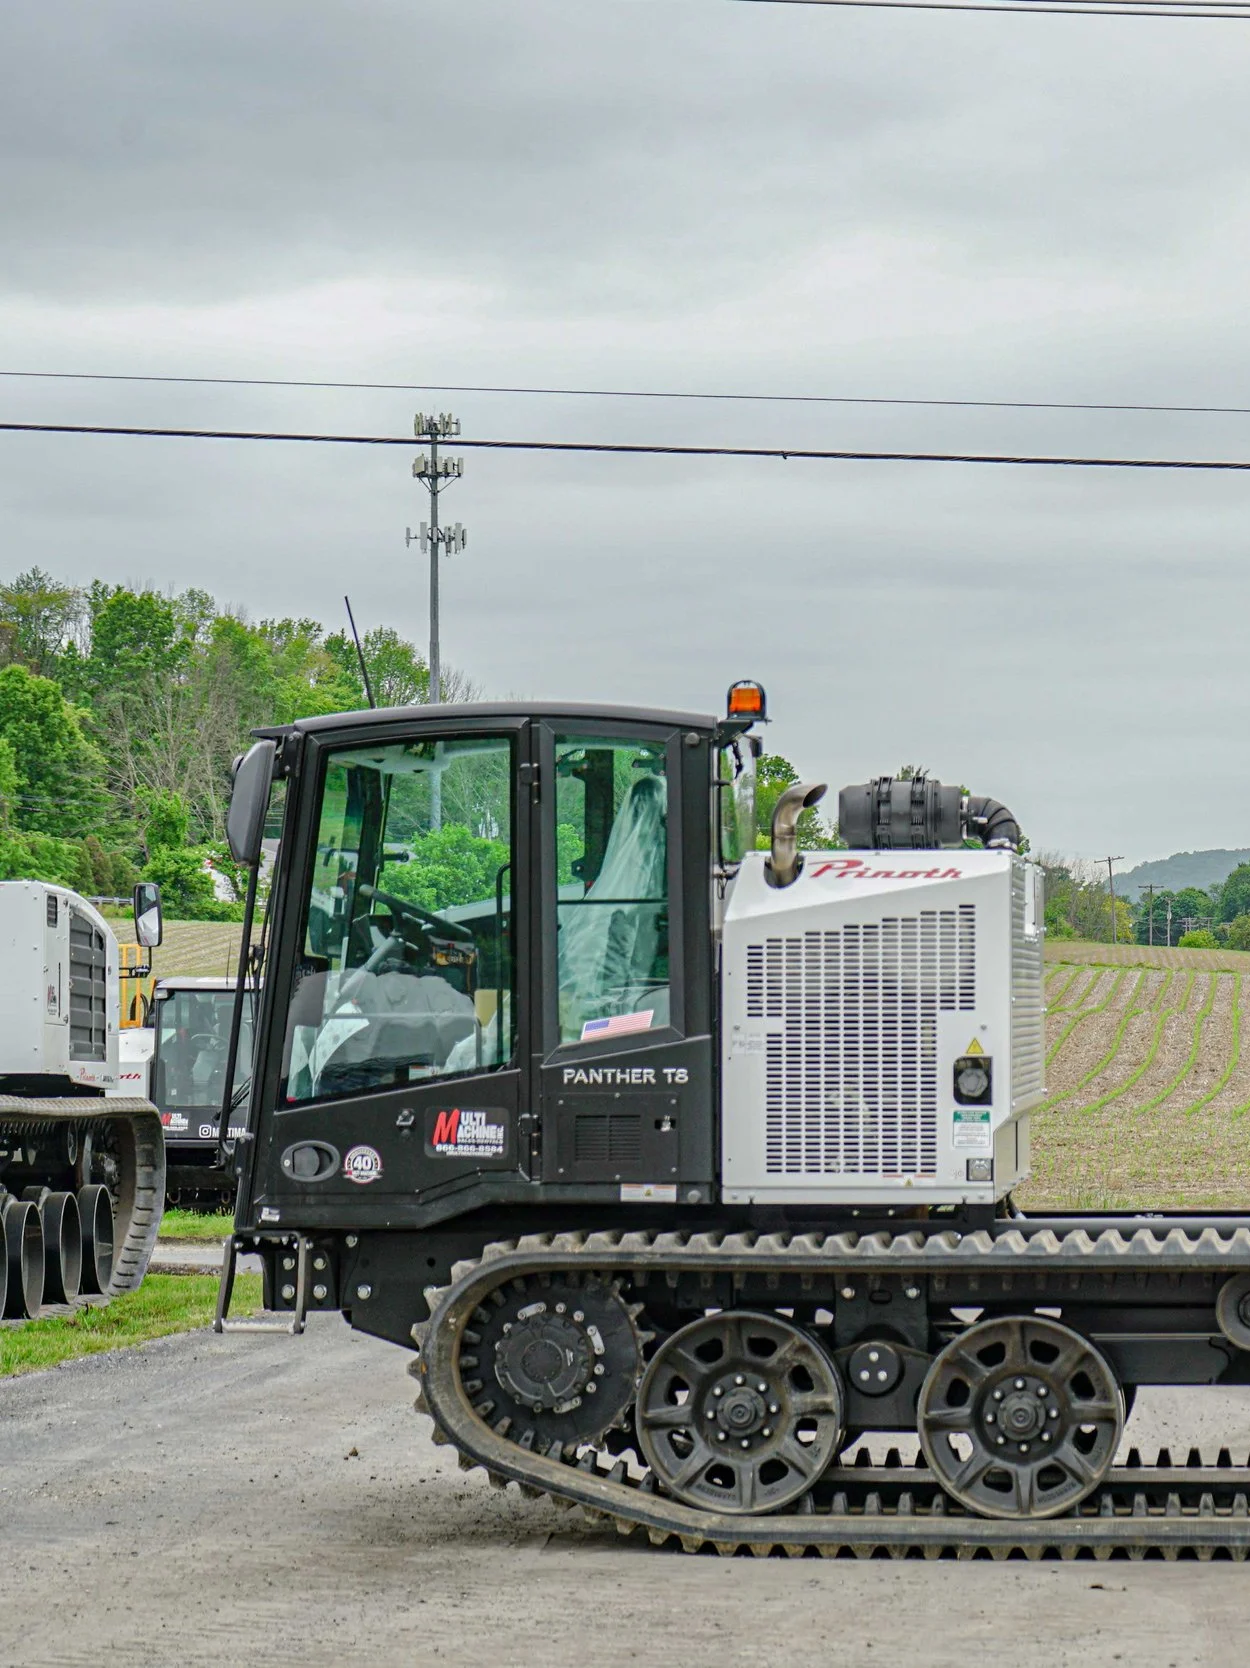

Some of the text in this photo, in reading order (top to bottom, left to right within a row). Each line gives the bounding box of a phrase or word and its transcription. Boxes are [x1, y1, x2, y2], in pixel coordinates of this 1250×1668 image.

[808, 859, 962, 878] Prinoth
[563, 1068, 689, 1084] PANTHER T8
[212, 1127, 246, 1138] MTIMA
[353, 1155, 372, 1170] 40
